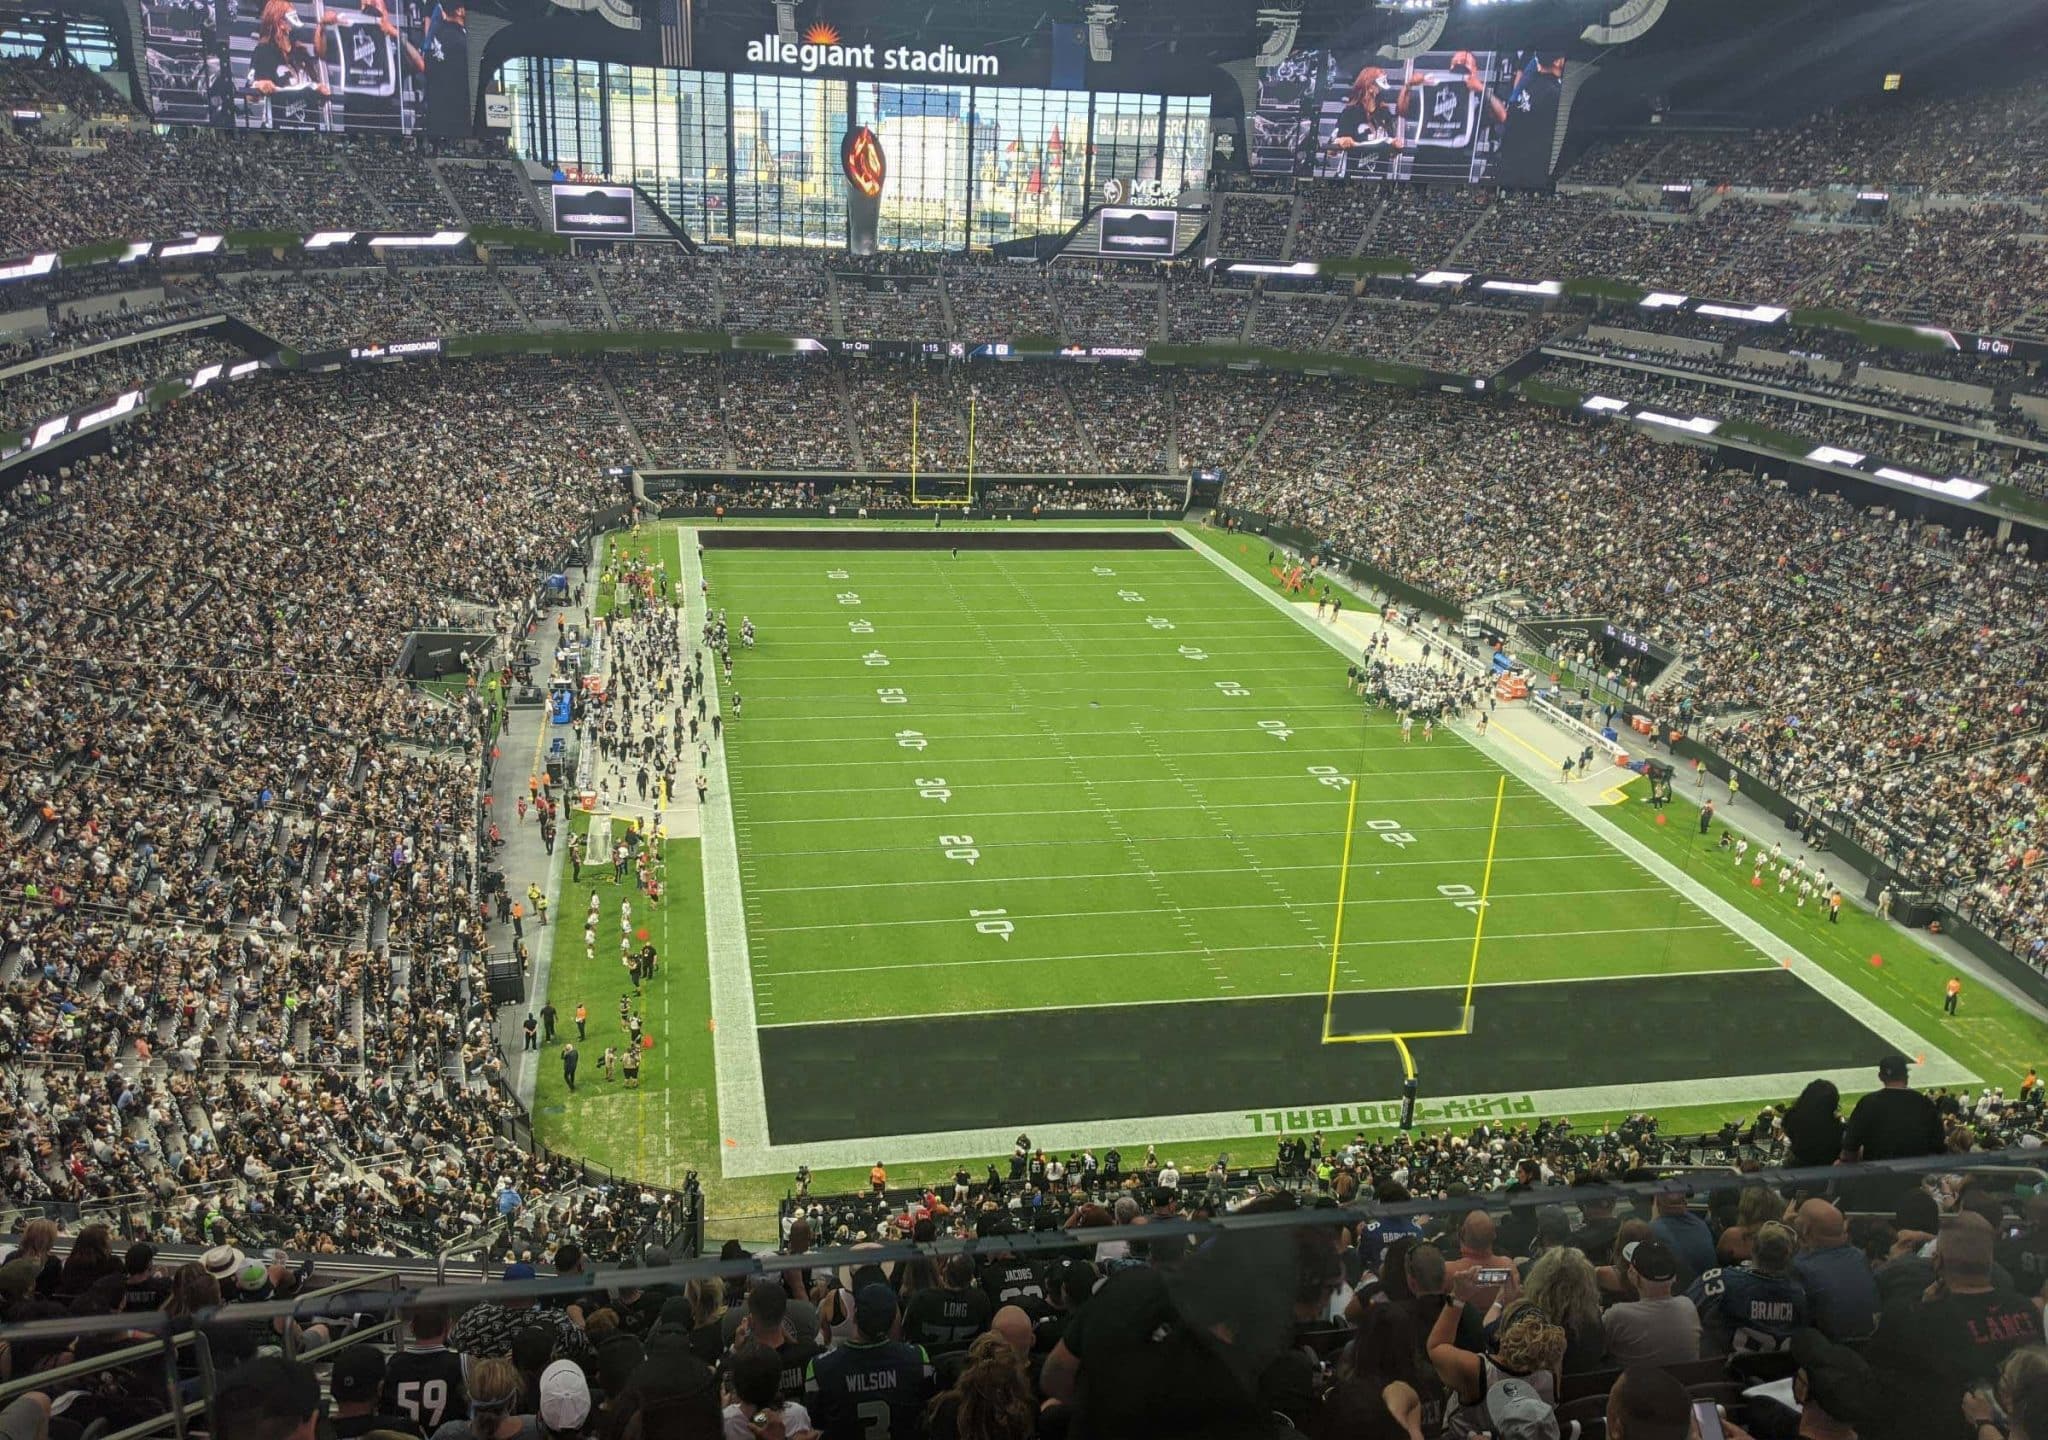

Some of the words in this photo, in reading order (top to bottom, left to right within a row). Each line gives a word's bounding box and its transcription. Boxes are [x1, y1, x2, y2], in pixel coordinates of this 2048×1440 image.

[747, 33, 875, 72] allegiant
[884, 43, 999, 76] stadium
[1130, 197, 1178, 207] RESORTS
[389, 341, 438, 353] SCOREBOARD
[922, 343, 939, 352] 1:15
[1092, 346, 1145, 357] SCOREBOARD
[1992, 340, 2010, 353] QTR
[1622, 632, 1637, 647] 1:15
[876, 687, 908, 704] 50
[1214, 681, 1250, 697] 50
[895, 728, 928, 748] 40
[1257, 720, 1294, 739] 40
[1307, 766, 1352, 786] 30
[914, 777, 952, 799] 30
[1366, 819, 1417, 844] 20
[938, 834, 980, 860] 20
[1436, 884, 1491, 909] 10
[969, 907, 1015, 935] 10
[1443, 1094, 1536, 1119] PLAY
[1245, 1101, 1426, 1133] FOOTBALL
[1004, 1267, 1033, 1283] JACOBS
[1702, 1267, 1726, 1297] 83
[943, 1300, 968, 1318] LONG
[1750, 1300, 1794, 1322] BRANCH
[845, 1369, 898, 1393] WILSON
[397, 1378, 448, 1428] 59
